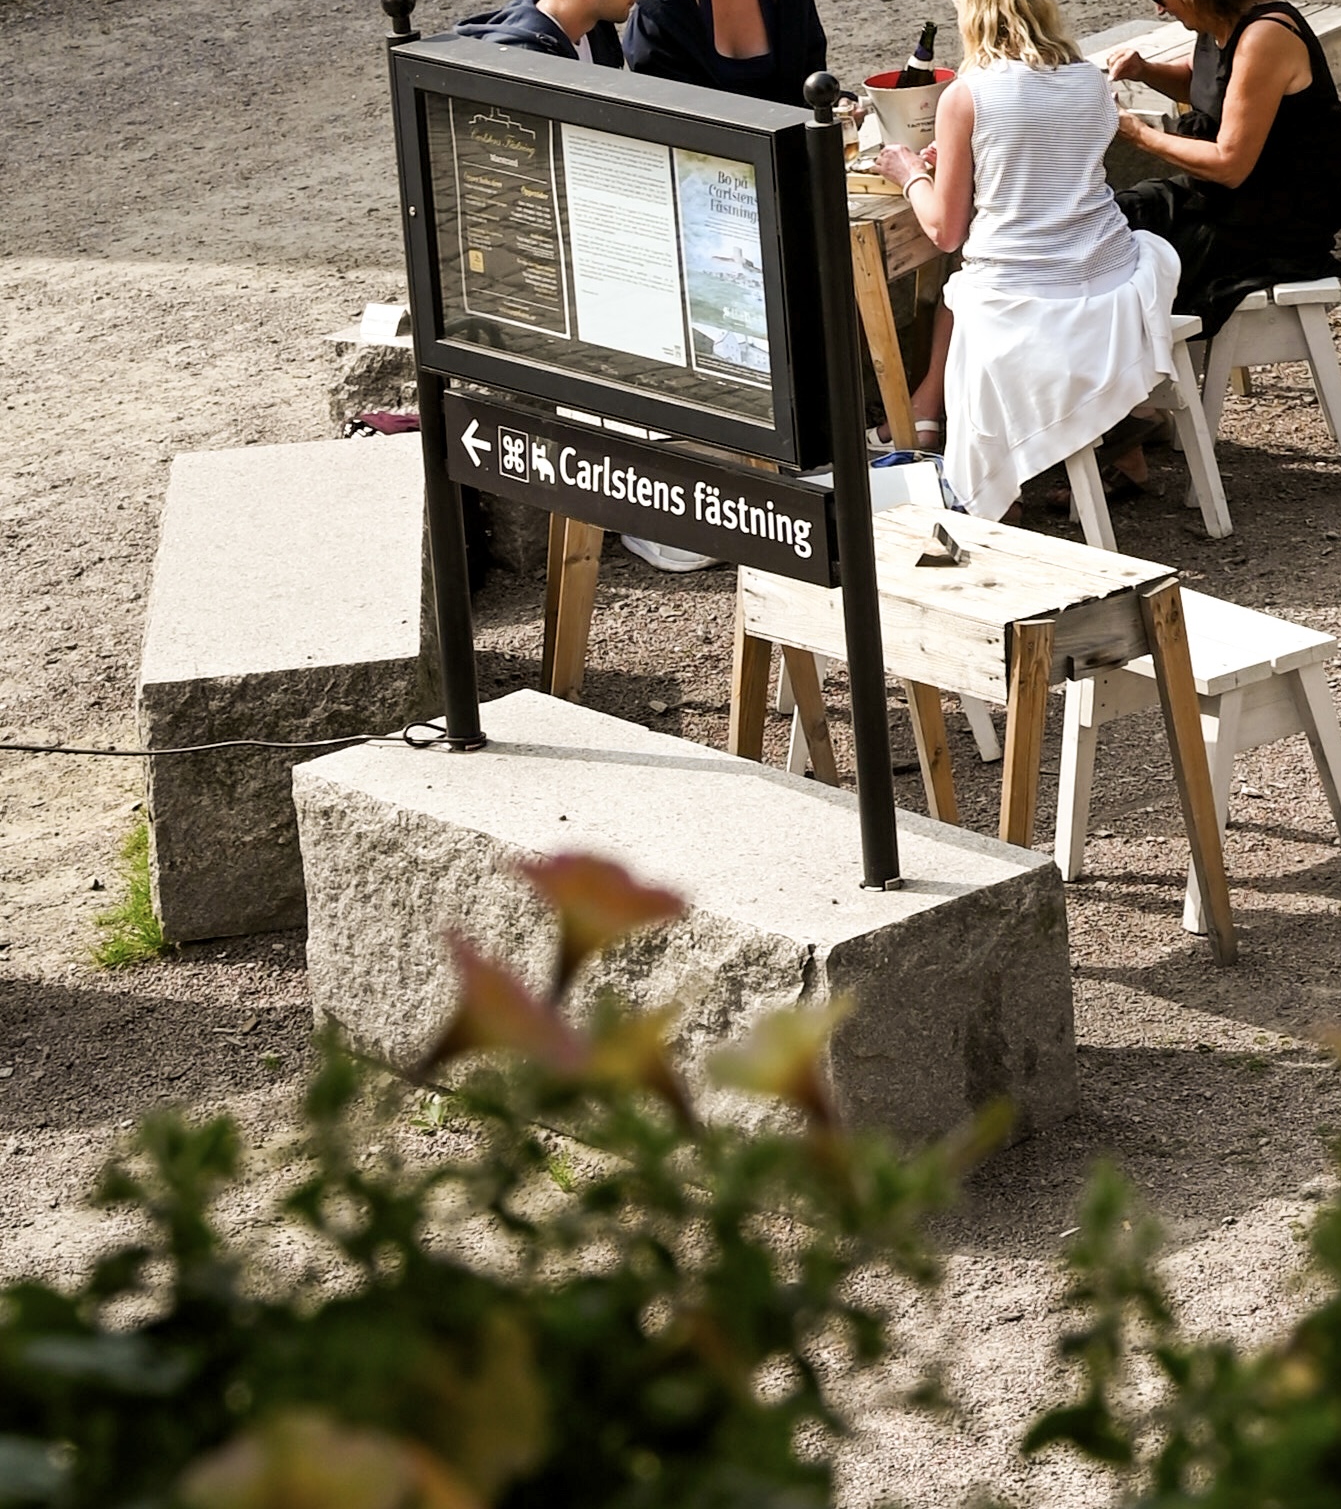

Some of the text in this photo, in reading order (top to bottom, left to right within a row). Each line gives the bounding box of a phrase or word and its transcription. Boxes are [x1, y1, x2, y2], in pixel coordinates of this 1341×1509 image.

[717, 170, 748, 191] Bo på
[710, 198, 757, 225] Fästning
[559, 447, 813, 559] Carlstens fästning
